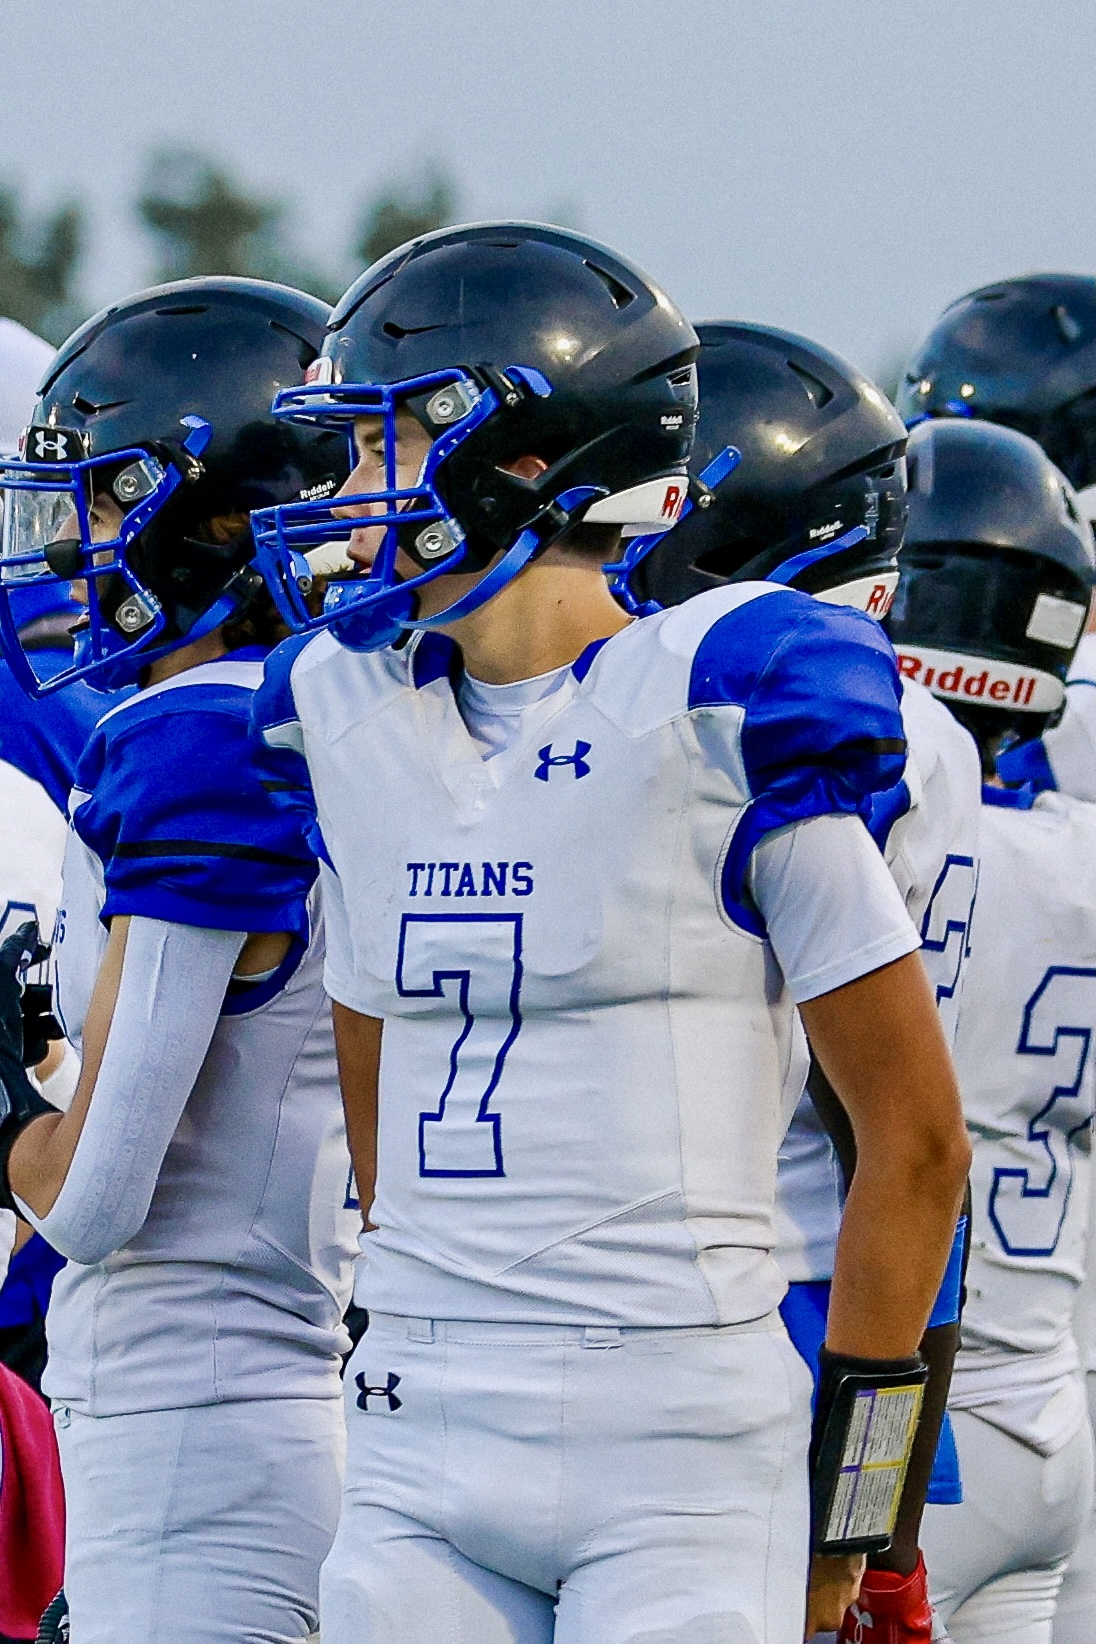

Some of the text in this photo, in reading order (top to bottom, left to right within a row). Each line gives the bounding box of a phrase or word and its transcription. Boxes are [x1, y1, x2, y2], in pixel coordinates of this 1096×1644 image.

[897, 654, 1036, 705] Riddell
[406, 861, 534, 897] TITANS
[396, 912, 524, 1178] 7
